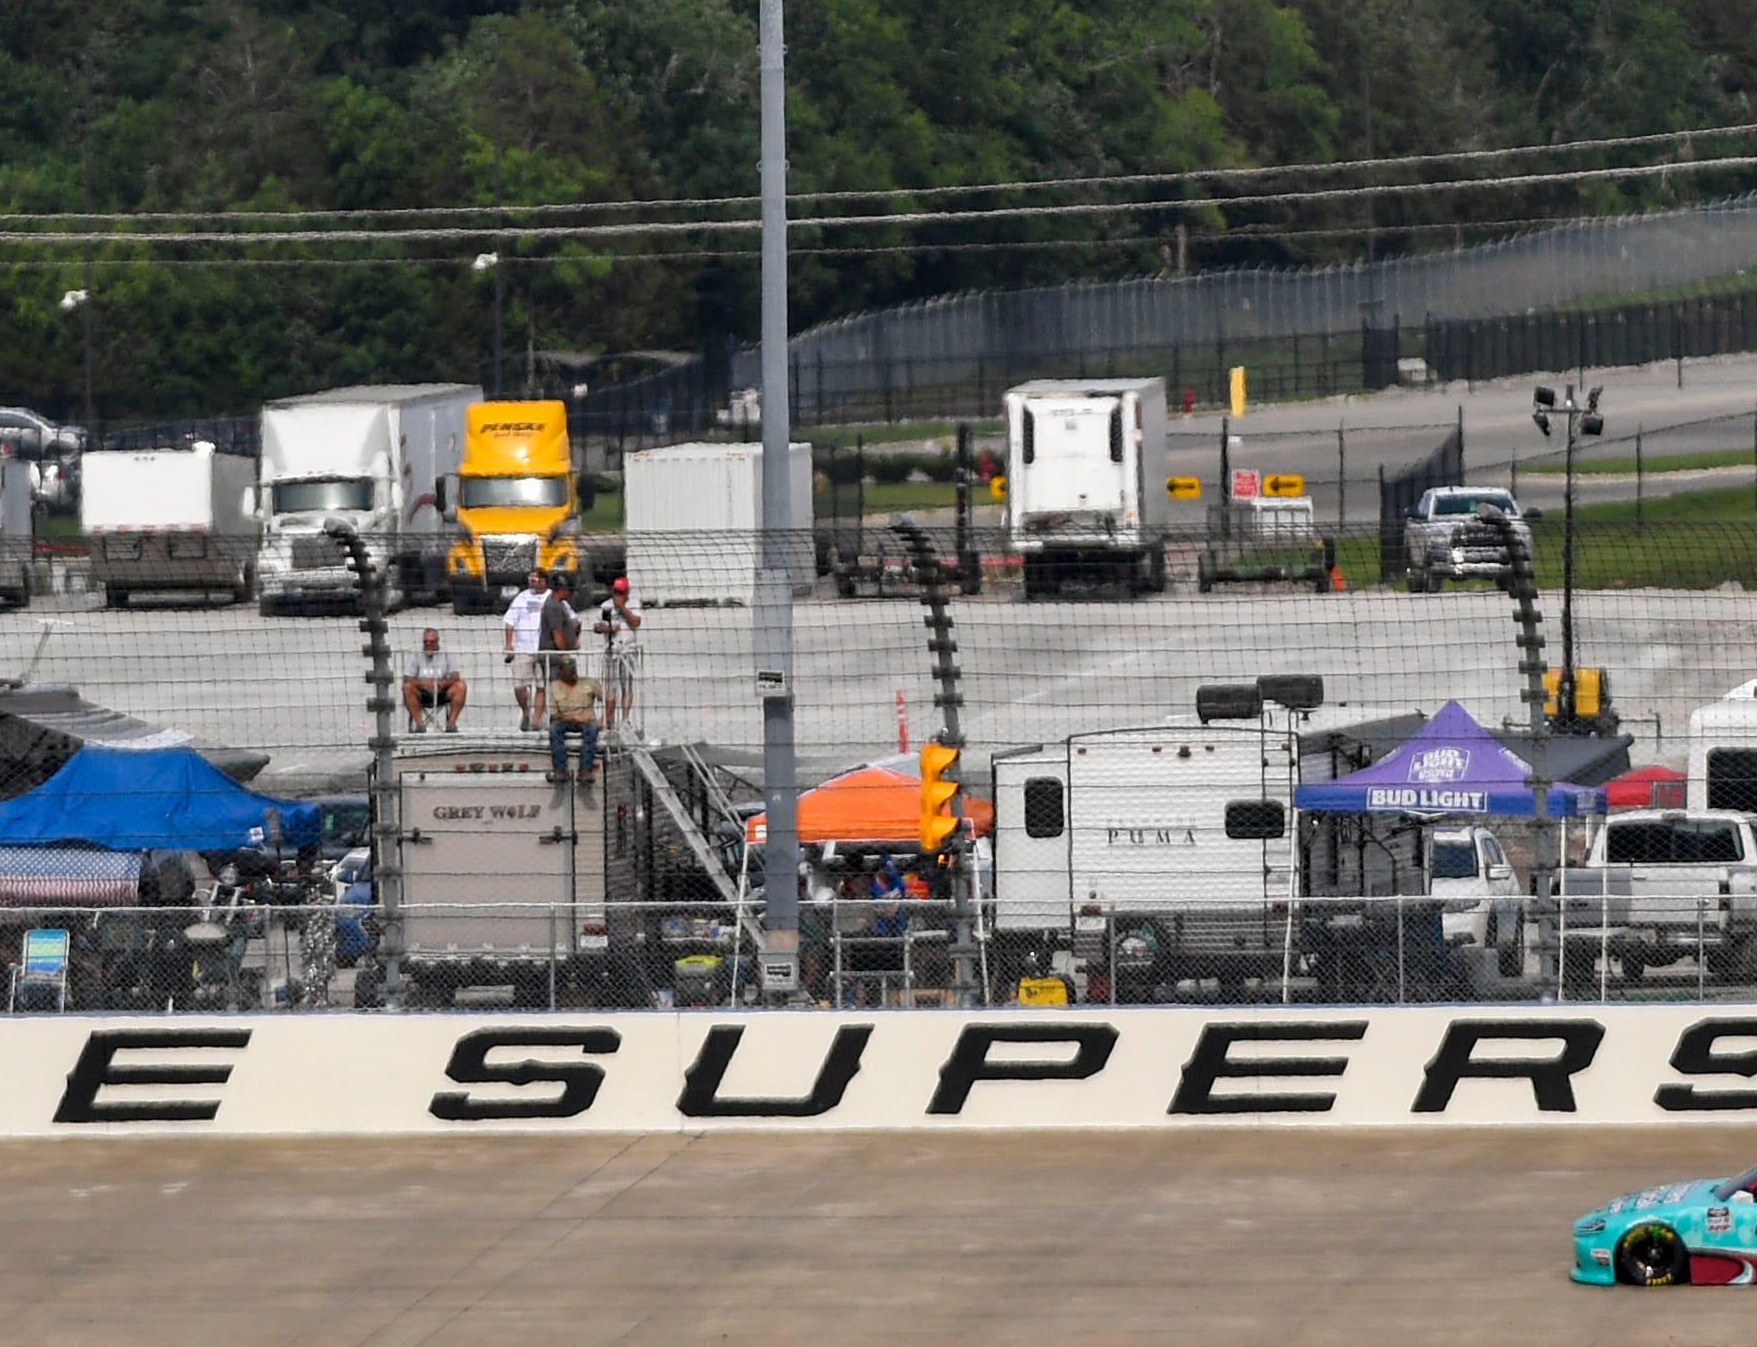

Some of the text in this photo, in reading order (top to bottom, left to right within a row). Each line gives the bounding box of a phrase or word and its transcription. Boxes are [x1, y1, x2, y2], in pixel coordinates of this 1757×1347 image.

[1371, 789, 1484, 808] BUD LIGHT
[433, 806, 484, 820] GREY
[1107, 827, 1196, 844] PUMA
